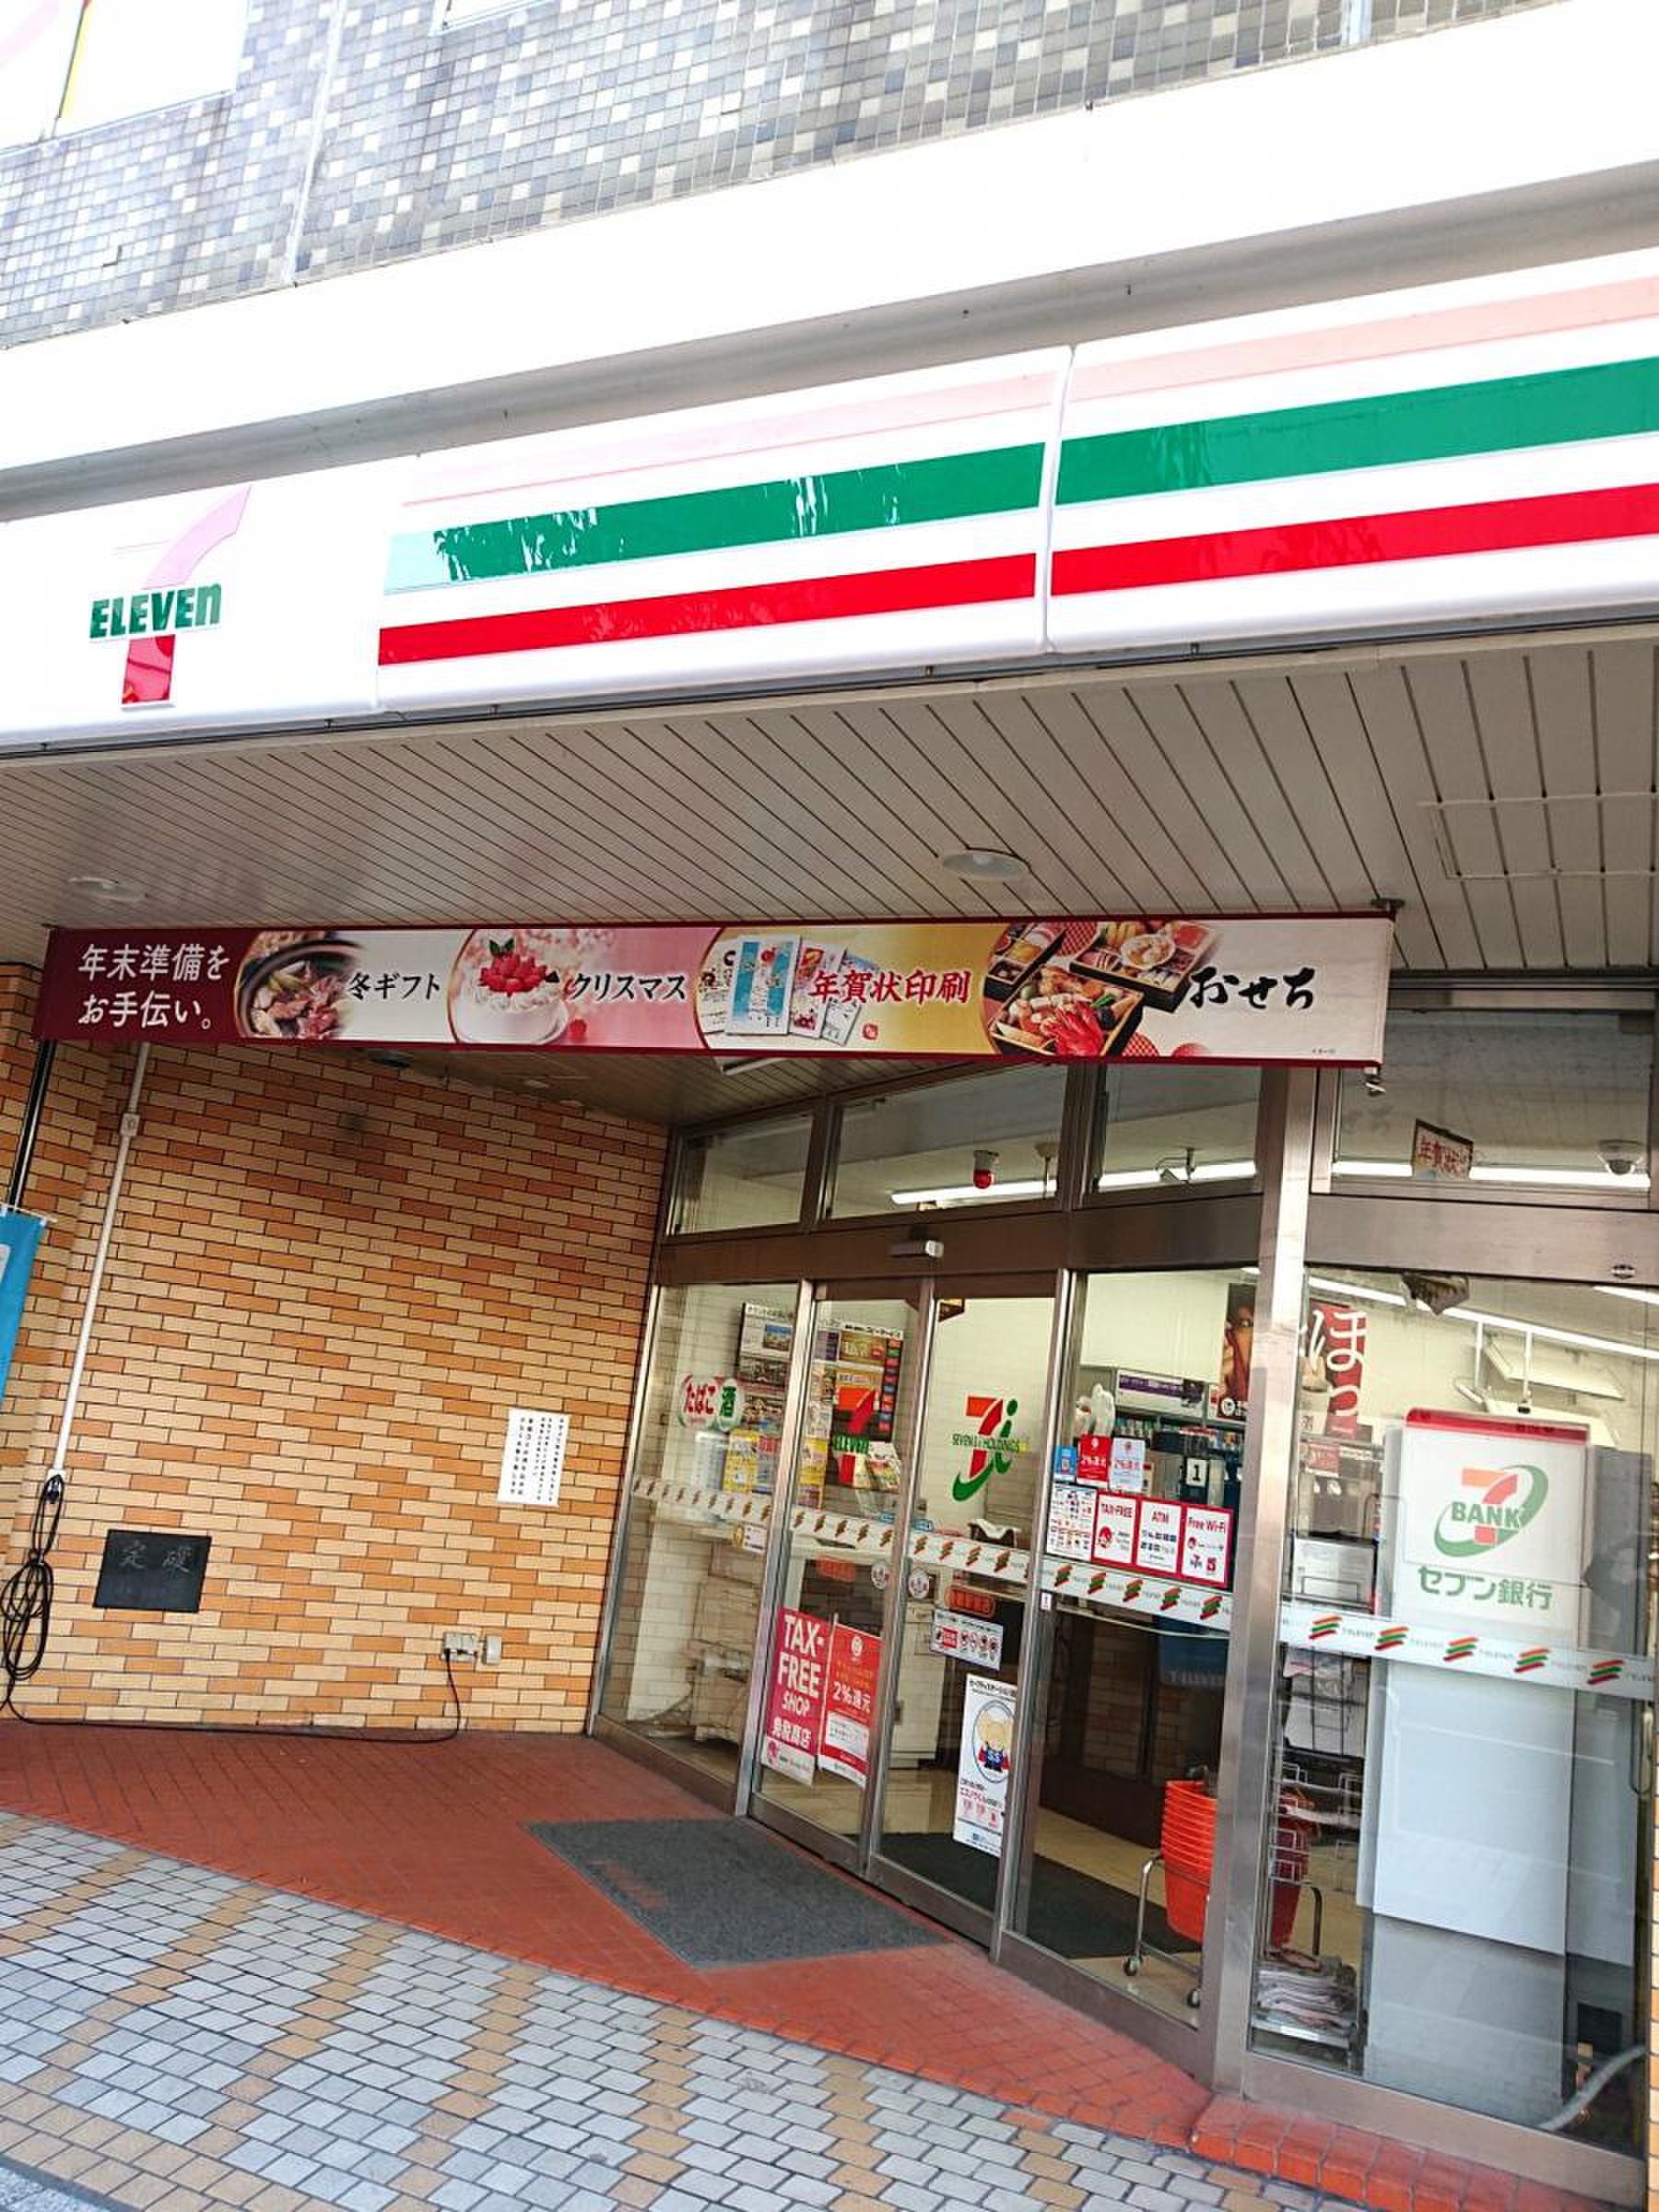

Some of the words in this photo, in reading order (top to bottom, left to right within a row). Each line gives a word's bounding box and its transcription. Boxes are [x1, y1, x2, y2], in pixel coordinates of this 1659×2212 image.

[78, 942, 230, 982] 年末準備を
[349, 971, 441, 1001] 冬ギフト
[569, 971, 687, 1003] クリスマス
[809, 969, 970, 1004] 年賀状印刷
[1189, 966, 1316, 1010] おせち
[78, 991, 213, 1030] お手伝い。
[1151, 1511, 1170, 1524] ATM
[1188, 1516, 1204, 1530] Free
[1450, 1500, 1522, 1528] BANK
[1418, 1565, 1553, 1611] セブン銀行
[783, 1614, 825, 1658] TAX-
[777, 1651, 821, 1700] FREE
[782, 1689, 810, 1717] SHOP
